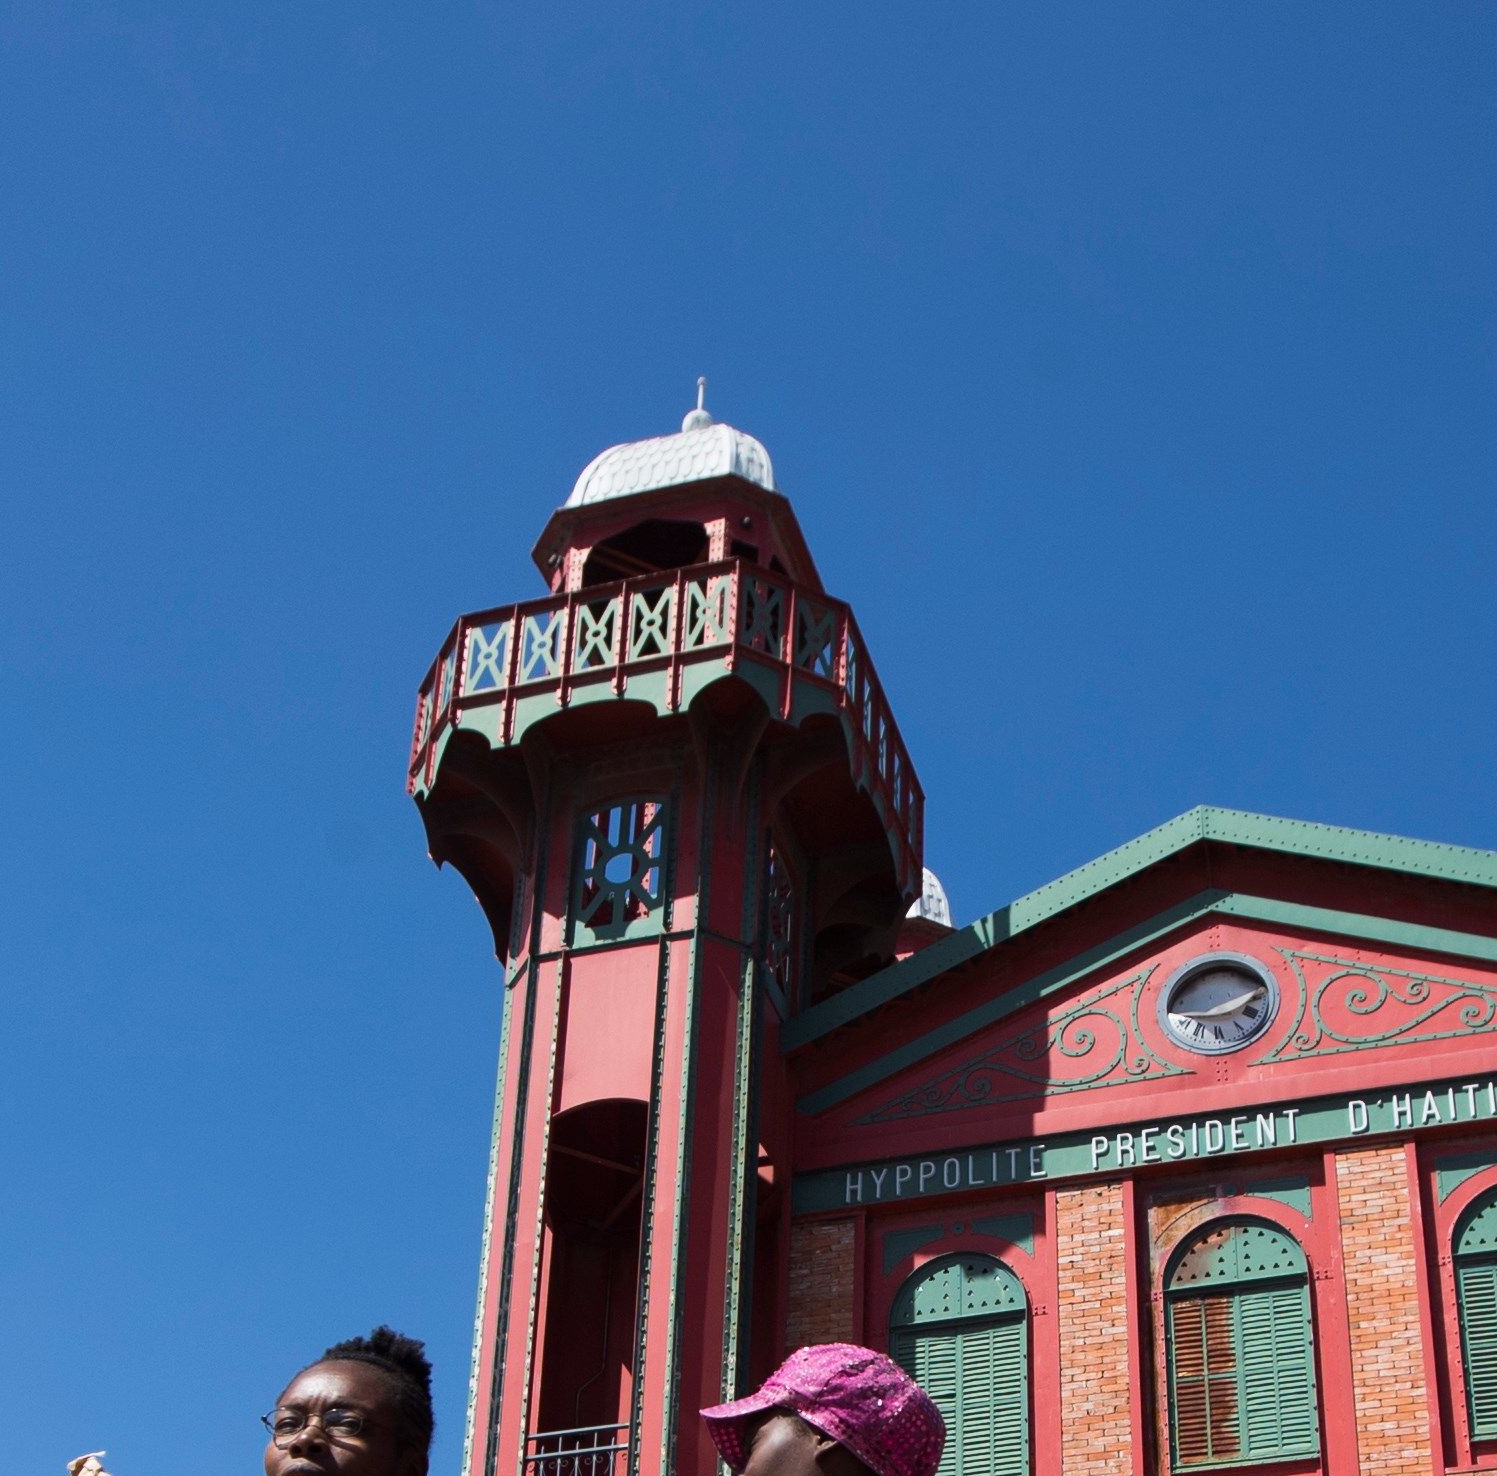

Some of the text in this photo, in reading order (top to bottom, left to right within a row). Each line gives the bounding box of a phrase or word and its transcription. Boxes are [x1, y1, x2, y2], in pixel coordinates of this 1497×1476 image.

[844, 1144, 1048, 1204] HYPPOLITE
[1091, 1108, 1302, 1170] PRESIDENT
[1347, 1081, 1497, 1135] D'HAITI
